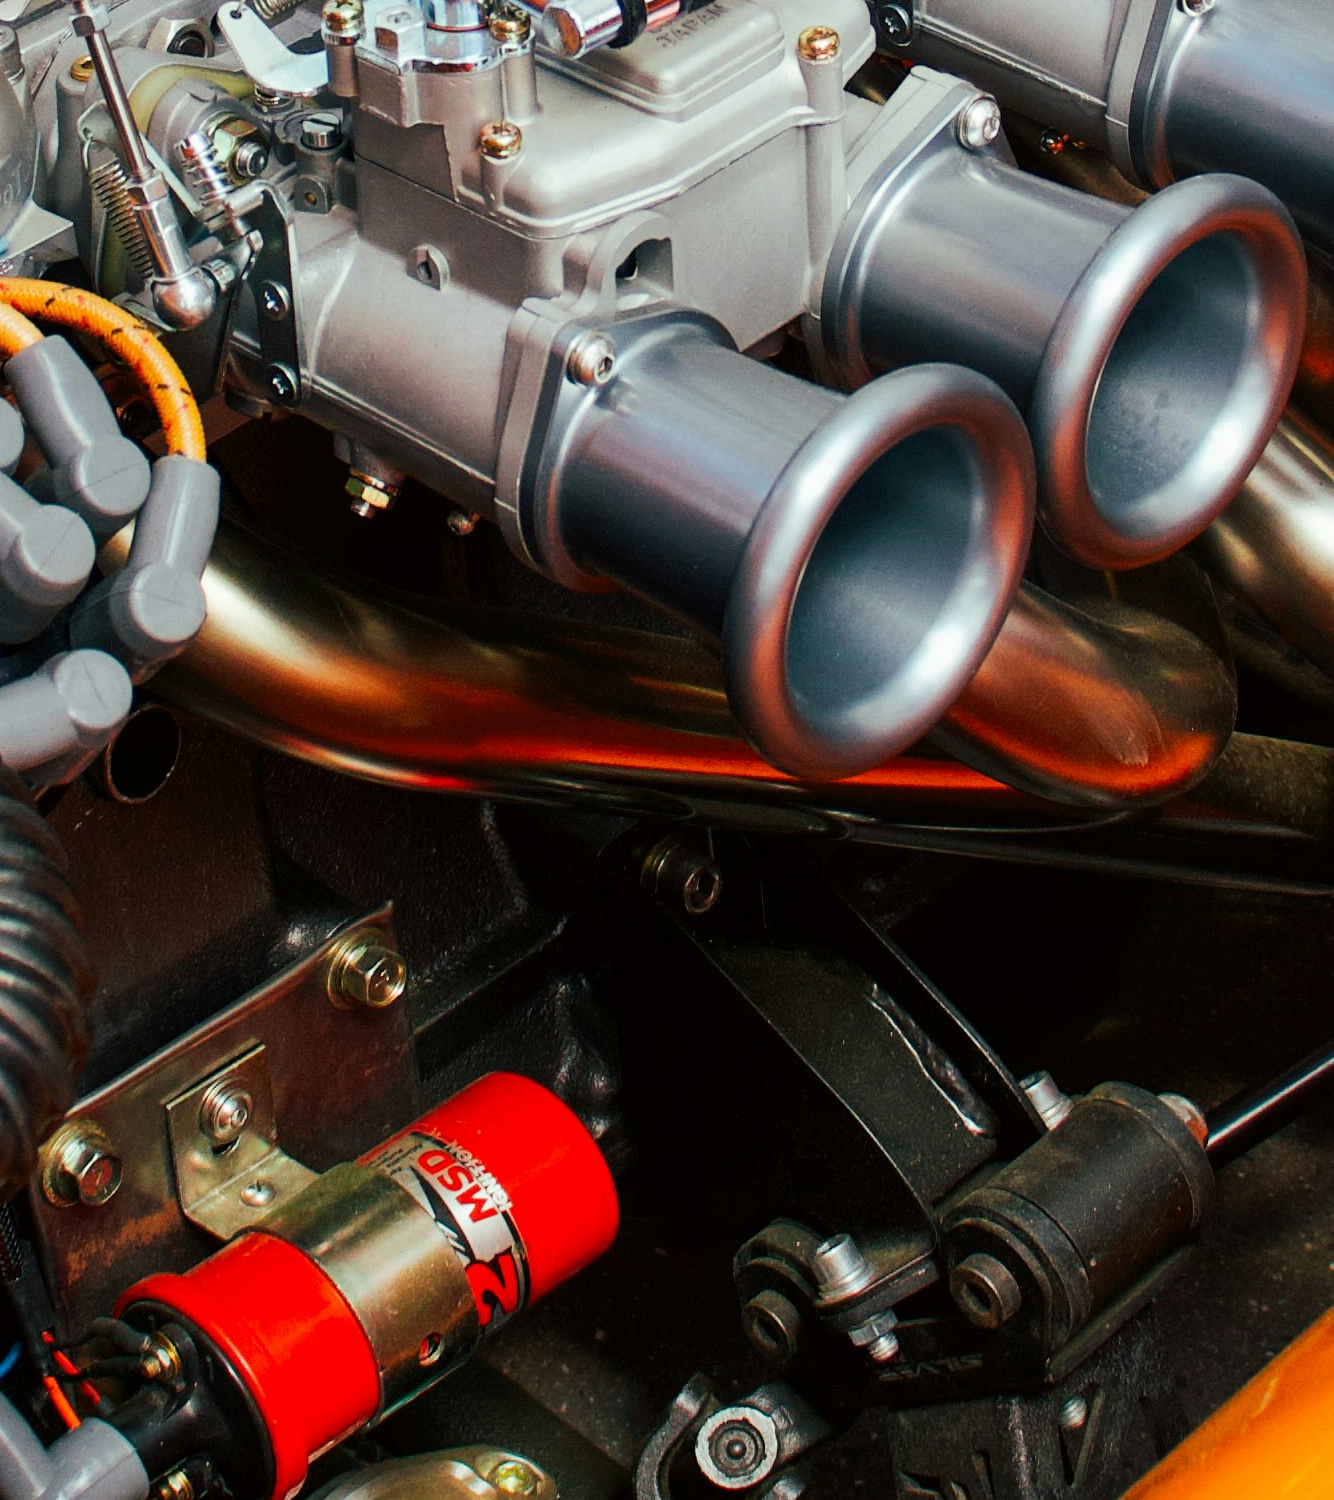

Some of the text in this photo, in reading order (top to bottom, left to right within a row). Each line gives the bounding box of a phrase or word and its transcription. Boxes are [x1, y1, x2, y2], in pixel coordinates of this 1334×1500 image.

[656, 4, 727, 47] JAPAN
[417, 1149, 497, 1226] MSD
[446, 1139, 513, 1213] IGNITION
